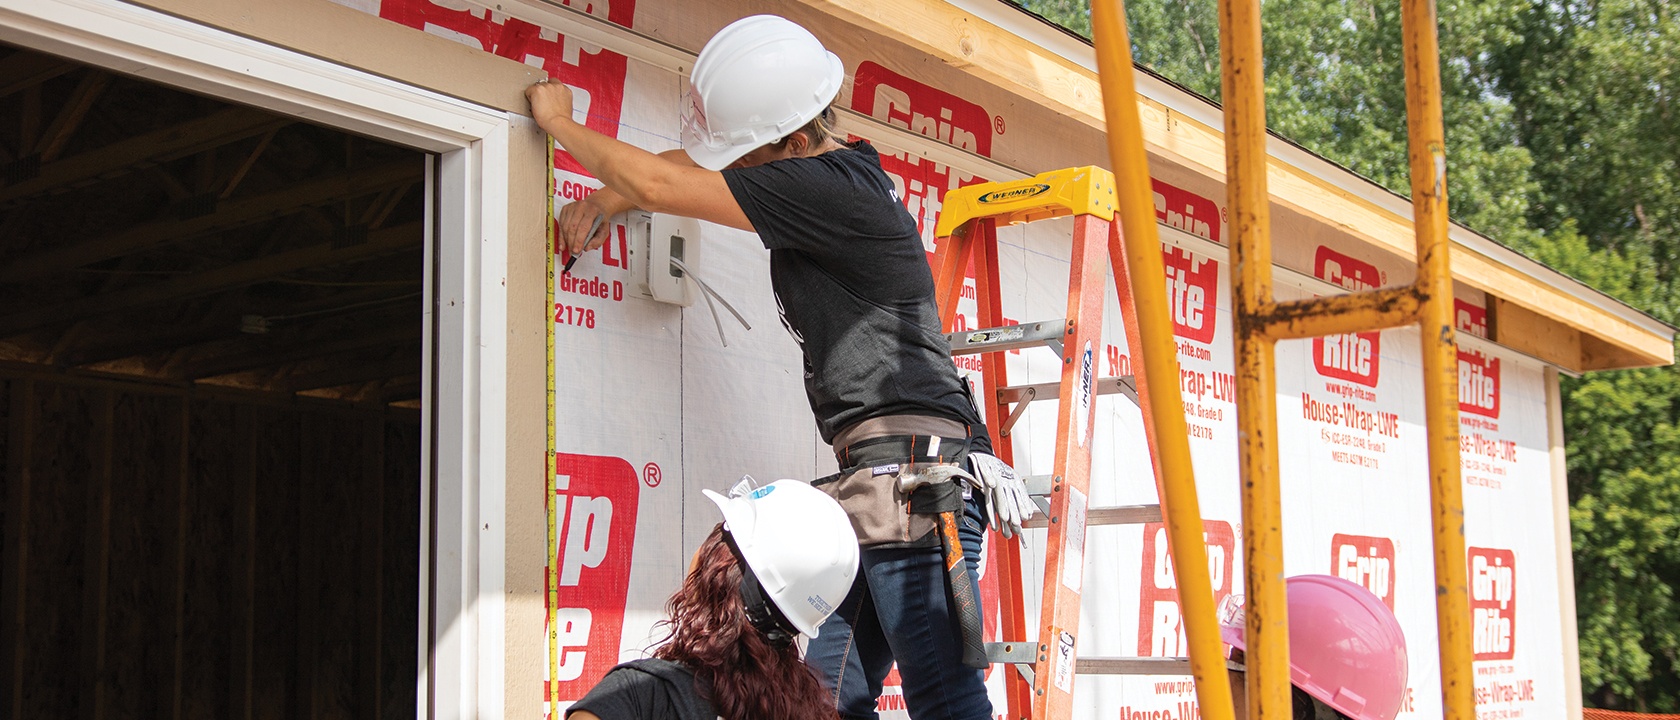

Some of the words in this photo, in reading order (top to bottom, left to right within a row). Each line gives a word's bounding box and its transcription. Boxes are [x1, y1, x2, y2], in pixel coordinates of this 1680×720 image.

[560, 269, 609, 299] Grade
[613, 280, 623, 301] D
[1165, 265, 1205, 331] ite
[554, 304, 595, 329] 2178
[1322, 332, 1372, 377] Rite
[1458, 359, 1494, 411] Rite
[1197, 404, 1217, 421] Grade
[1302, 391, 1399, 439] House-Wrap-LWE
[556, 474, 613, 586] ip
[1472, 555, 1513, 610] Grip
[1473, 608, 1511, 655] Rite
[1154, 677, 1195, 697] www.grip-
